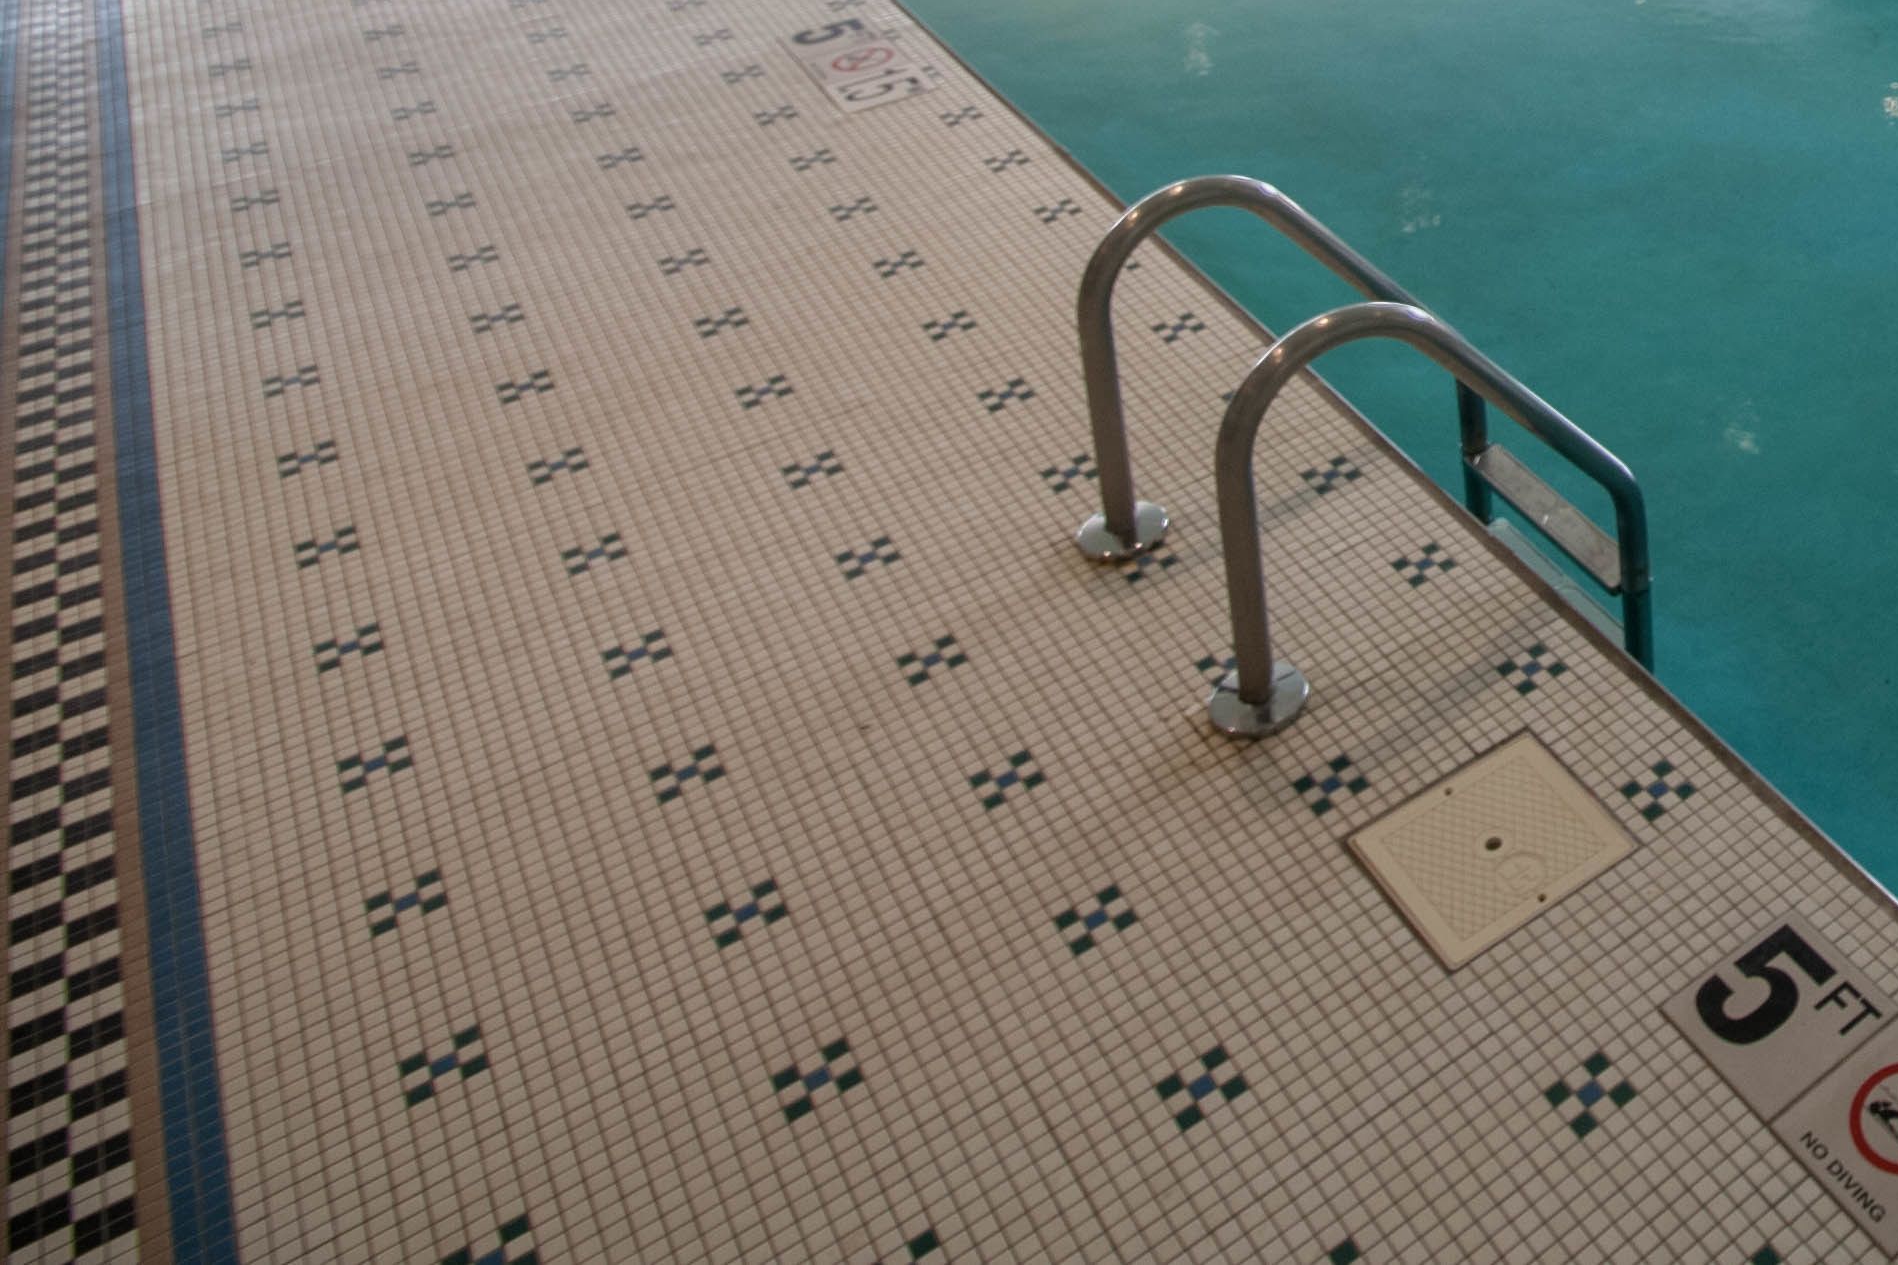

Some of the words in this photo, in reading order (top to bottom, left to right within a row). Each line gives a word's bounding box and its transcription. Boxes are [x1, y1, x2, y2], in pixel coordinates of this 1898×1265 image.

[793, 18, 864, 45] 5
[1696, 923, 1837, 1046] 5
[1813, 981, 1883, 1037] FT
[1800, 1130, 1829, 1160] NO
[1826, 1159, 1887, 1224] DIVING
